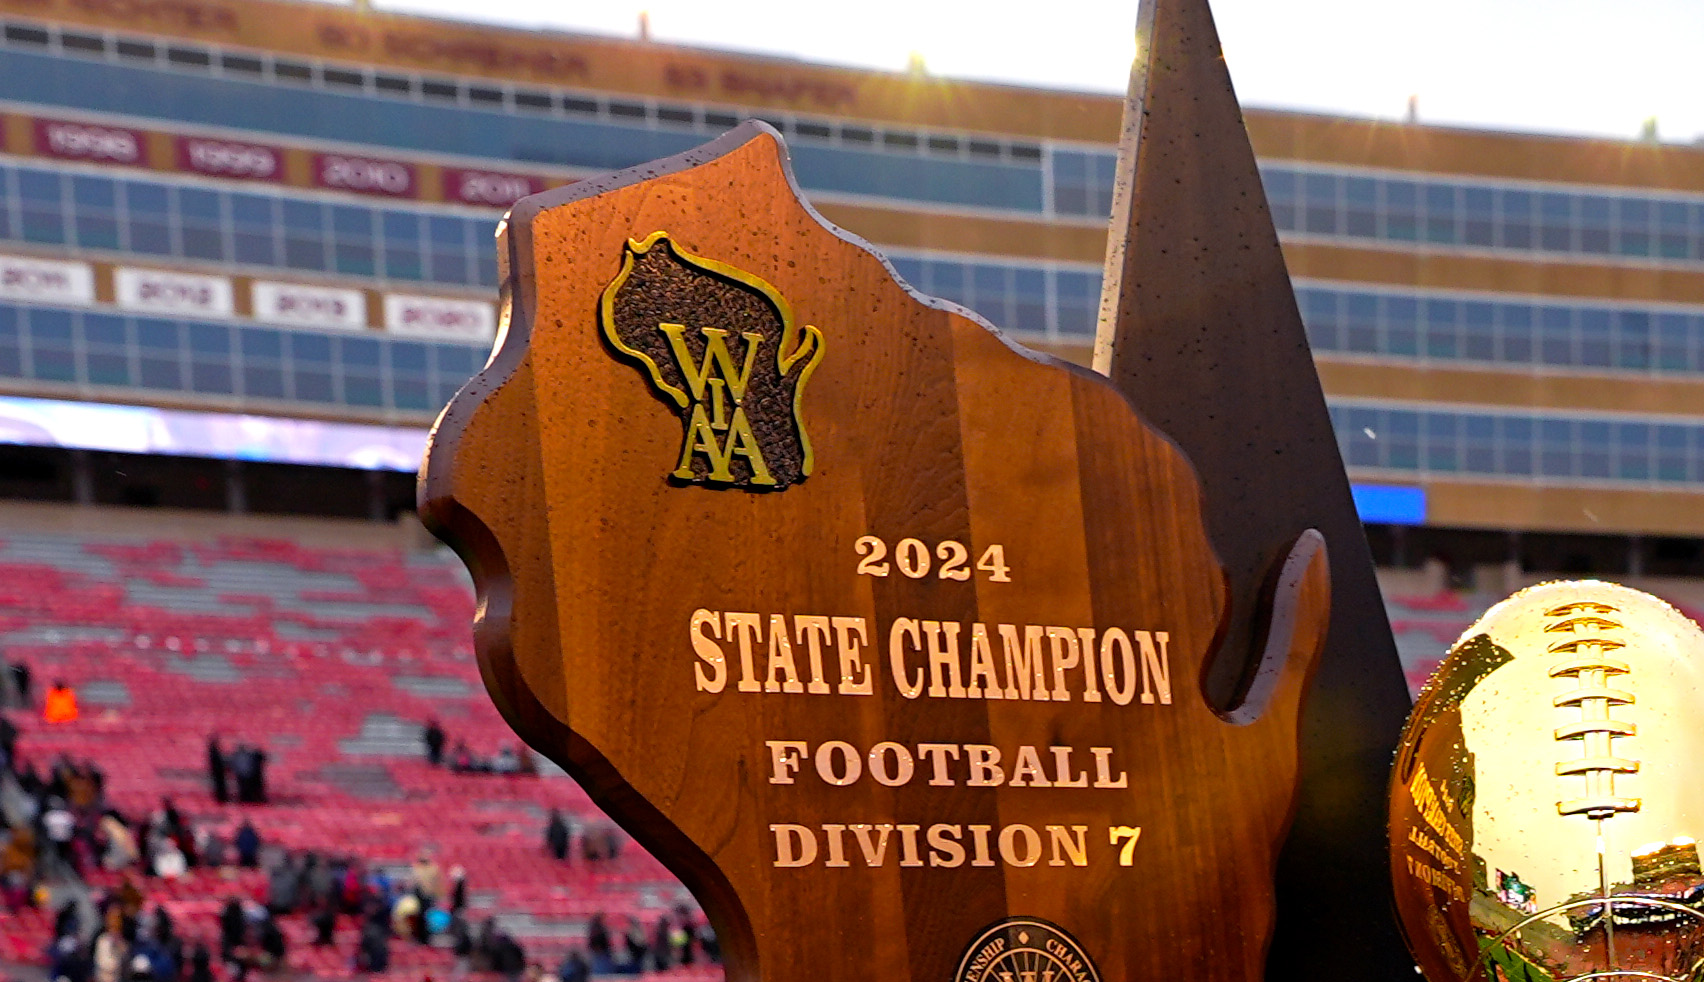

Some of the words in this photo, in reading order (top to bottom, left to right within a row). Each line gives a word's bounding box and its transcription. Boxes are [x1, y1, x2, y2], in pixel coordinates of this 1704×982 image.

[854, 535, 1012, 583] 2024
[689, 607, 874, 697] STATE
[889, 616, 1173, 707] CHAMPION
[764, 739, 1129, 789] FOOTBALL
[768, 823, 1089, 869] DIVISION
[1108, 825, 1142, 867] 7
